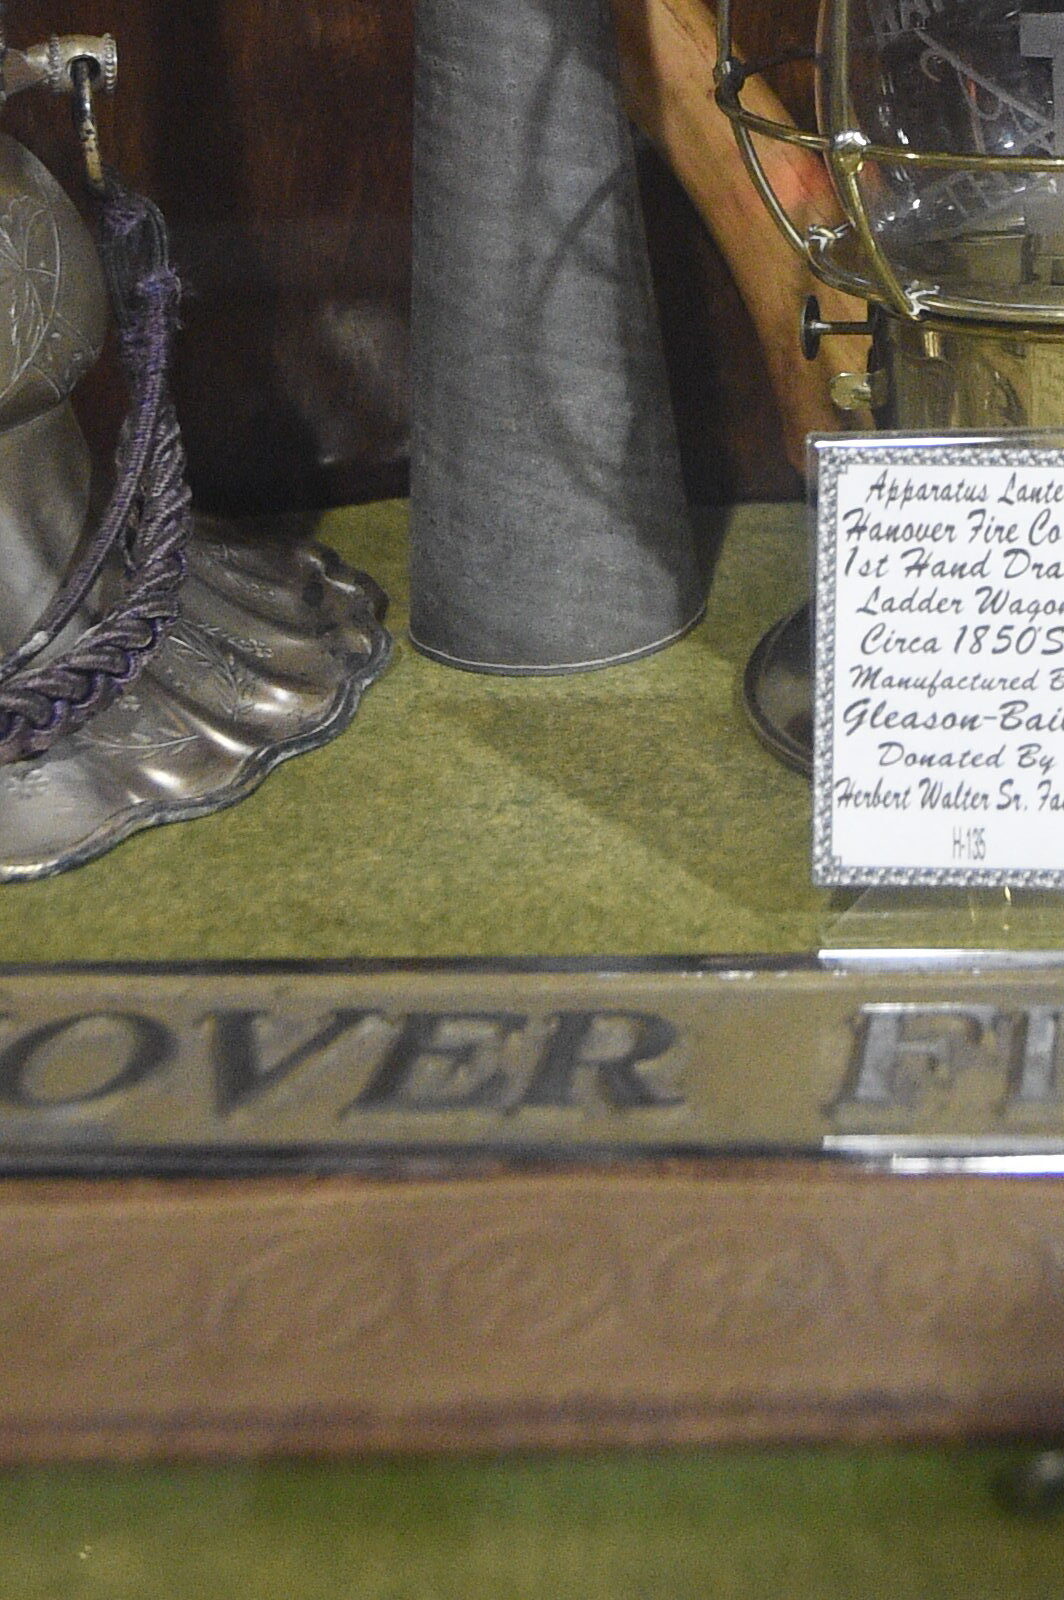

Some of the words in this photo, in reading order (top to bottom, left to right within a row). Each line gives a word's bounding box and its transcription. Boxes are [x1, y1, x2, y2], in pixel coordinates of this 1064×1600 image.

[865, 469, 988, 510] Apparatus
[842, 507, 957, 542] Hanover
[966, 508, 1020, 544] Fire
[843, 545, 889, 579] 1st
[900, 546, 993, 580] Hand
[855, 585, 965, 616] Ladder
[859, 622, 943, 656] Circa
[848, 664, 1040, 699] Manufactured
[877, 741, 1008, 768] Donated
[1016, 742, 1058, 776] By
[833, 776, 912, 811] Herbert
[918, 776, 990, 811] Walter
[996, 778, 1028, 812] Sr.
[951, 826, 987, 861] H-135
